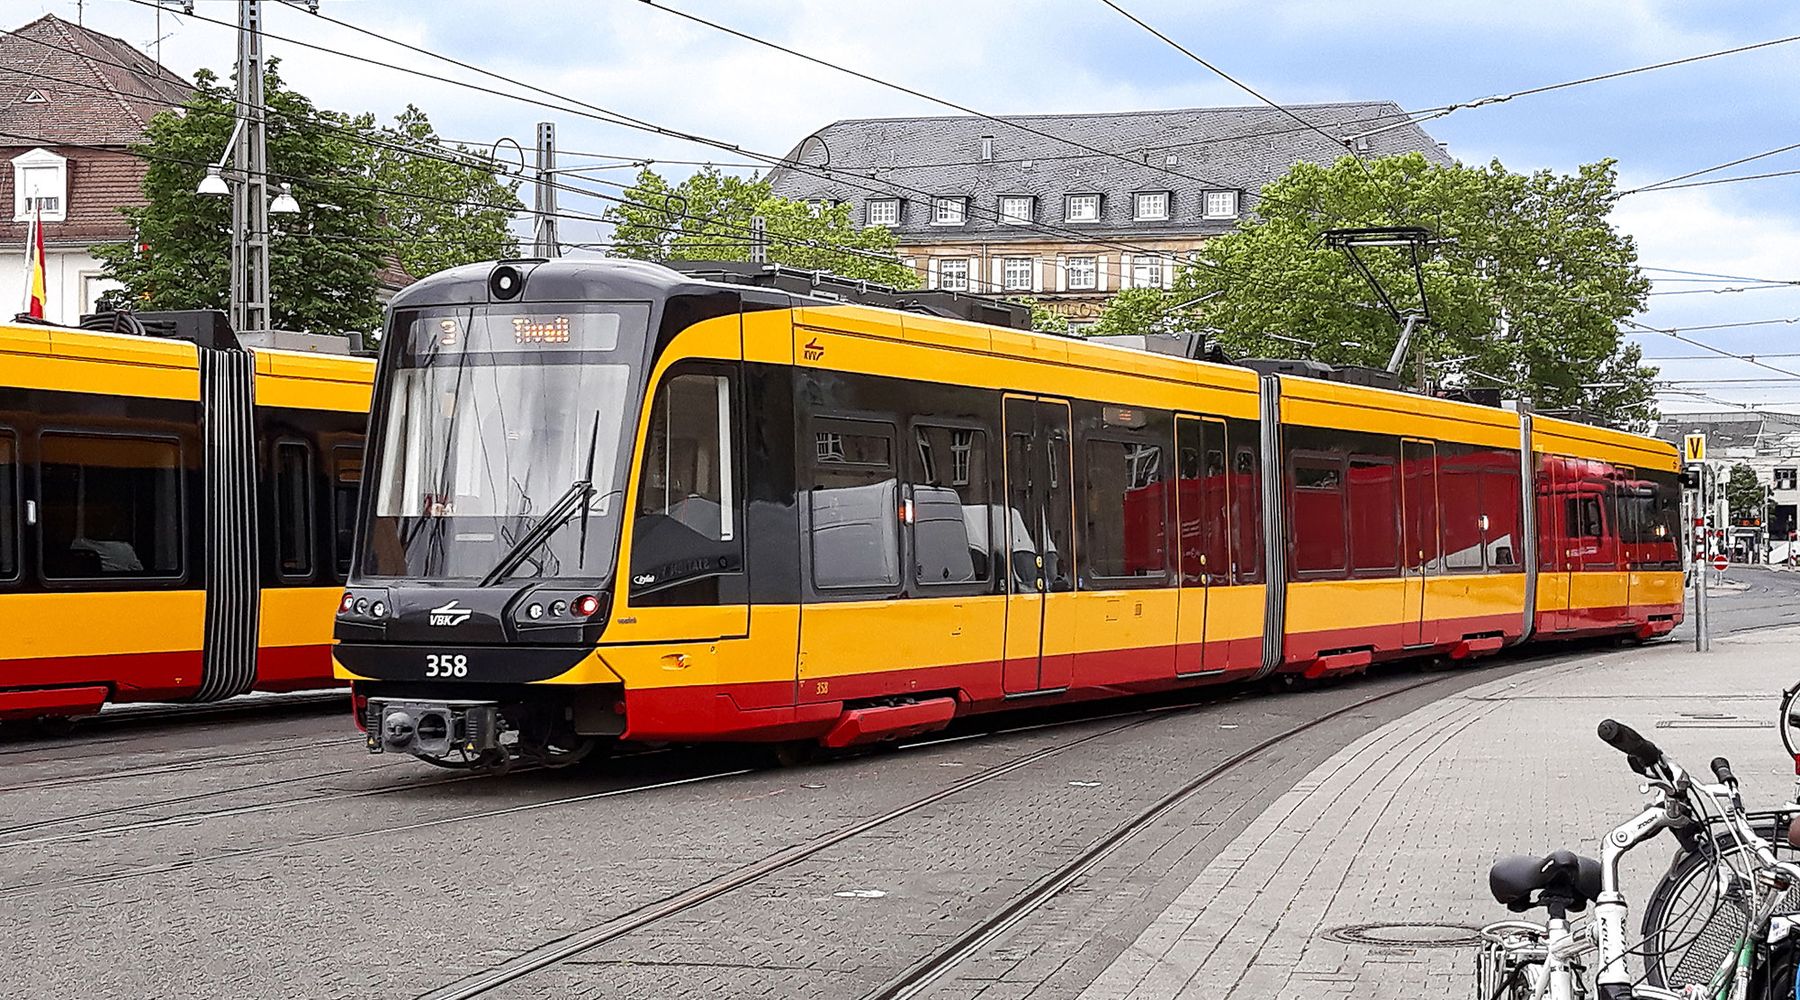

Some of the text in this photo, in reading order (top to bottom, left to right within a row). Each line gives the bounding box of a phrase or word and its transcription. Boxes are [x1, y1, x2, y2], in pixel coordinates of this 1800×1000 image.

[441, 317, 569, 345] 3 Tivoli
[1690, 437, 1701, 459] V
[429, 614, 454, 626] VBK
[426, 654, 468, 677] 358
[816, 681, 829, 695] 358
